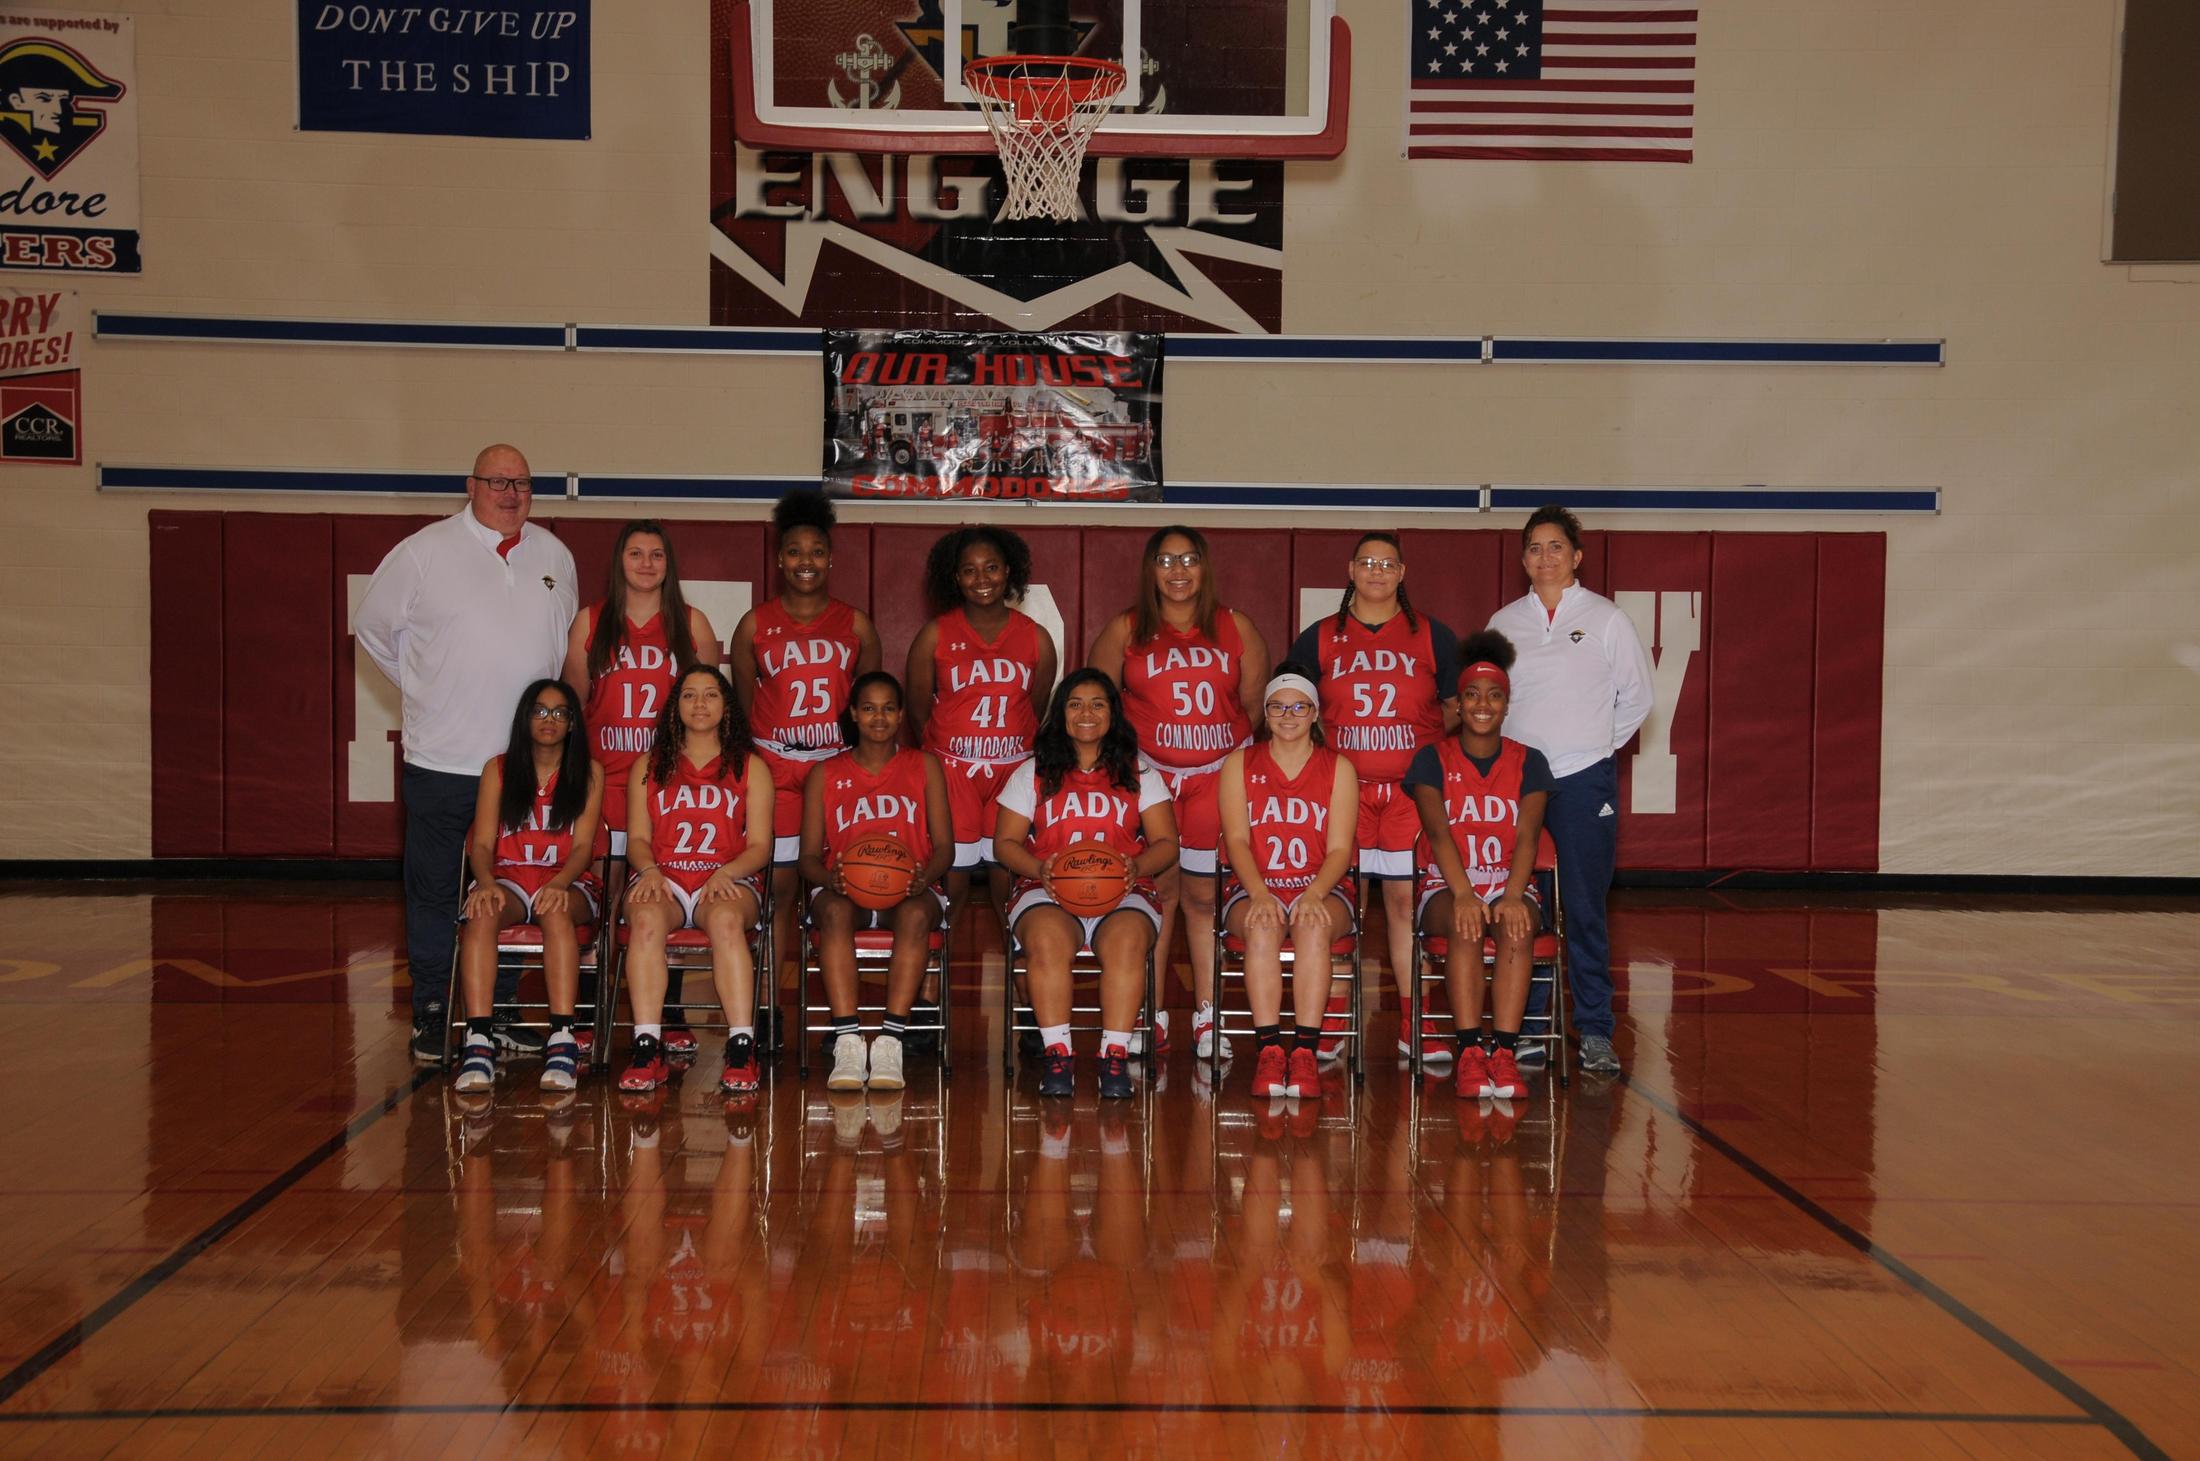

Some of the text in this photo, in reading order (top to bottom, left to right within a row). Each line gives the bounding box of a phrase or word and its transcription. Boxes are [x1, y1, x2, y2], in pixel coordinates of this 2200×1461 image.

[9, 16, 31, 26] are
[33, 17, 101, 31] supported
[104, 19, 120, 34] by
[315, 5, 577, 40] DONT GIVE UP
[341, 59, 570, 97] THE SHIP
[970, 353, 1142, 388] HOUSE
[763, 638, 851, 678] LADY
[950, 658, 1031, 693] LADY
[1147, 646, 1230, 679] LADY
[1331, 649, 1417, 681] LADY
[622, 683, 658, 719] 12
[789, 677, 831, 718] 25
[970, 695, 1008, 728] 41
[1172, 681, 1214, 716] 50
[1353, 682, 1397, 718] 52
[1155, 722, 1234, 751] COMMODORES
[1337, 724, 1415, 751] COMMODORES
[657, 784, 740, 819] LADY
[835, 794, 918, 833] LADY
[1045, 791, 1129, 828] LADY
[1247, 796, 1327, 832] LADY
[673, 821, 717, 854] 22
[1266, 835, 1308, 870] 20
[1466, 835, 1502, 867] 10
[1064, 854, 1114, 871] Rawlings
